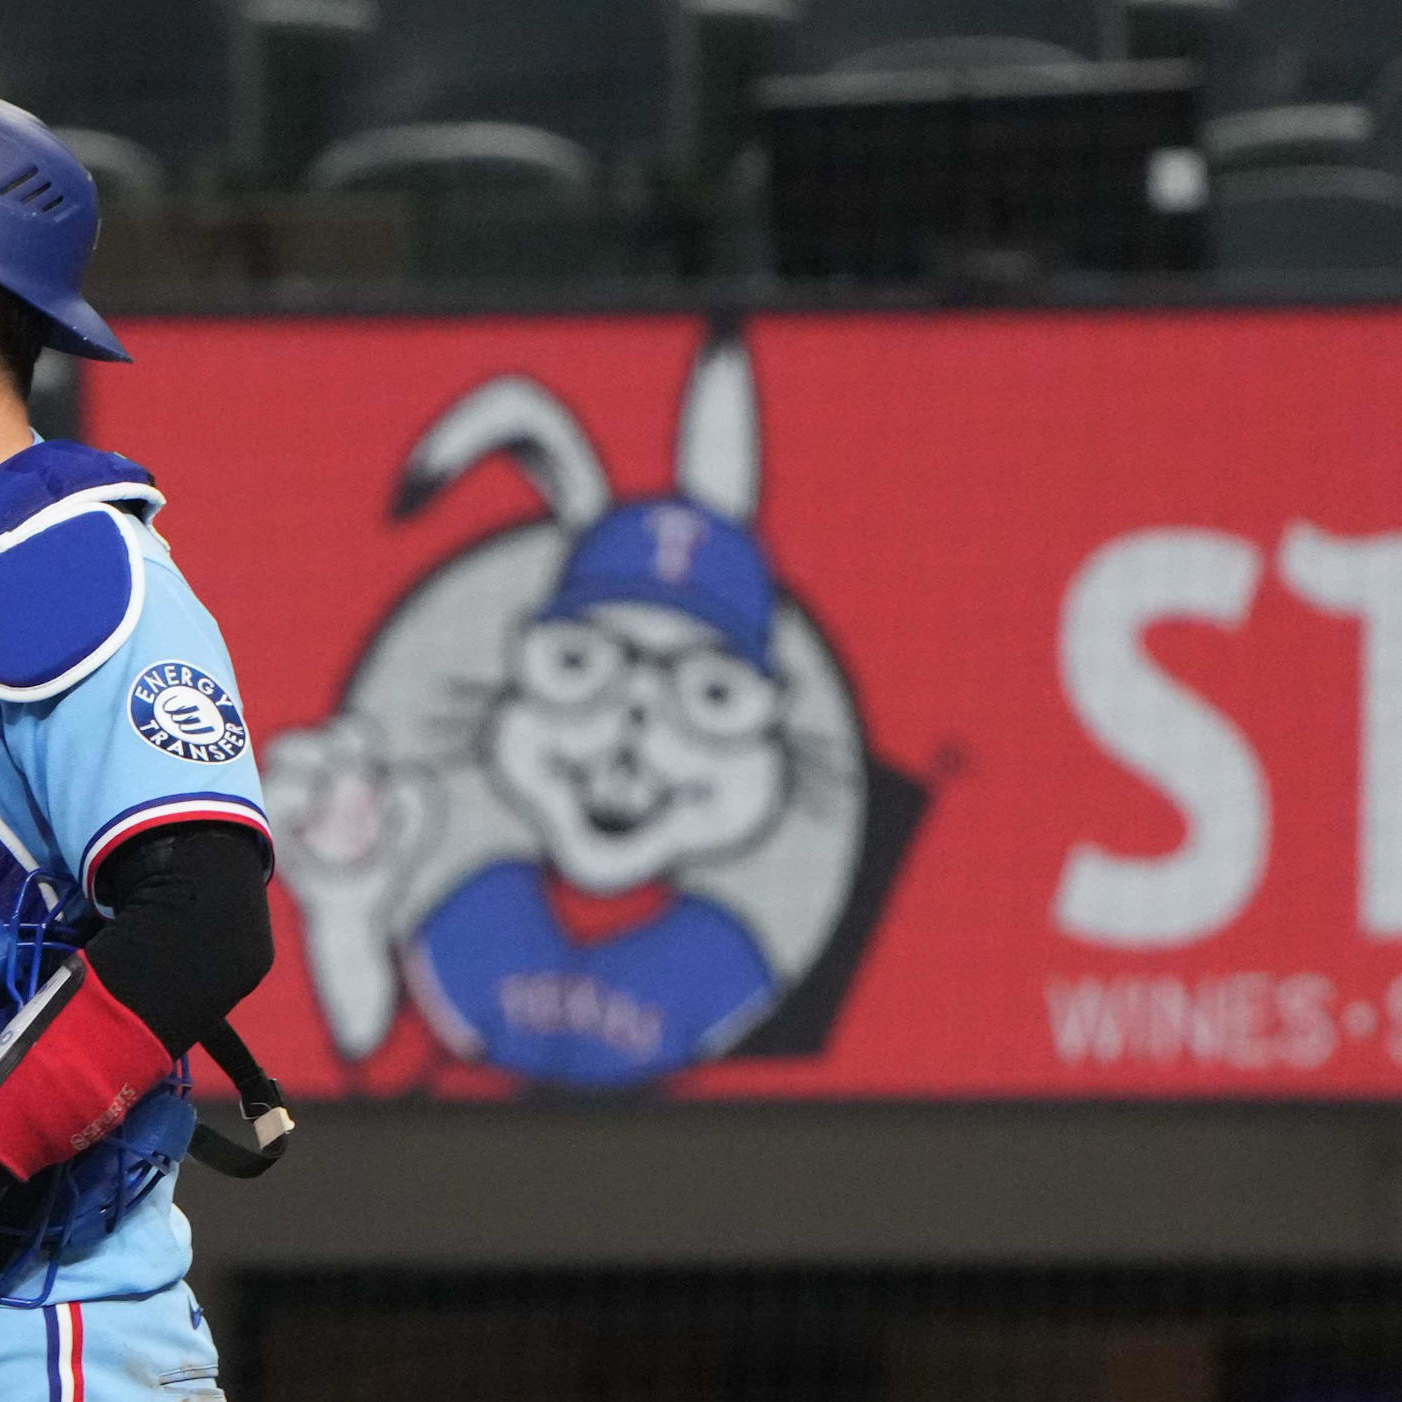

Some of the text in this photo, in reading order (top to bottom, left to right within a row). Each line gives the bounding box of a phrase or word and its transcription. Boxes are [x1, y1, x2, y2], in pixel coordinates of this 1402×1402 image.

[135, 665, 244, 762] ENERGY TRANSFER
[1044, 972, 1337, 1071] WINES
